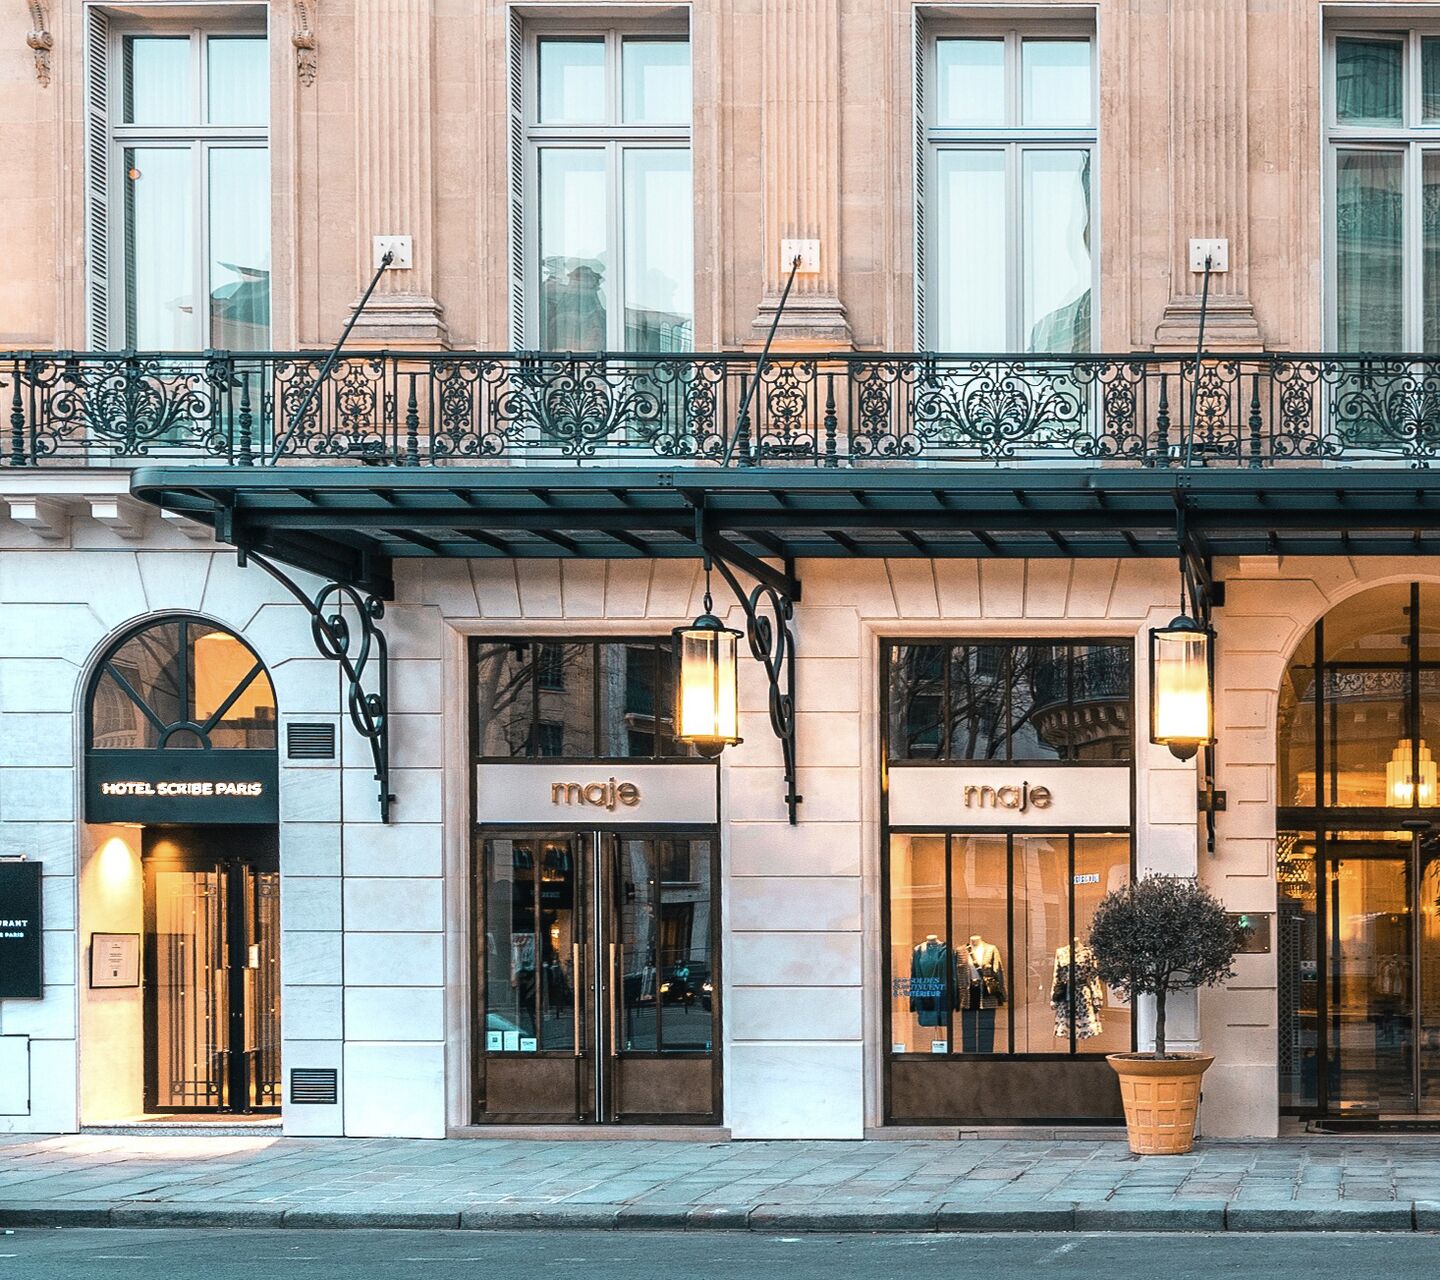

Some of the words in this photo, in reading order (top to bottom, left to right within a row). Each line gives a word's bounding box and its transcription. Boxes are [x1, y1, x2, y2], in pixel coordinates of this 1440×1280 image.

[101, 781, 156, 796] HOTEL
[156, 781, 213, 797] SCRIBE
[215, 781, 263, 797] PARIS
[552, 777, 640, 811] maje
[964, 781, 1052, 813] maje
